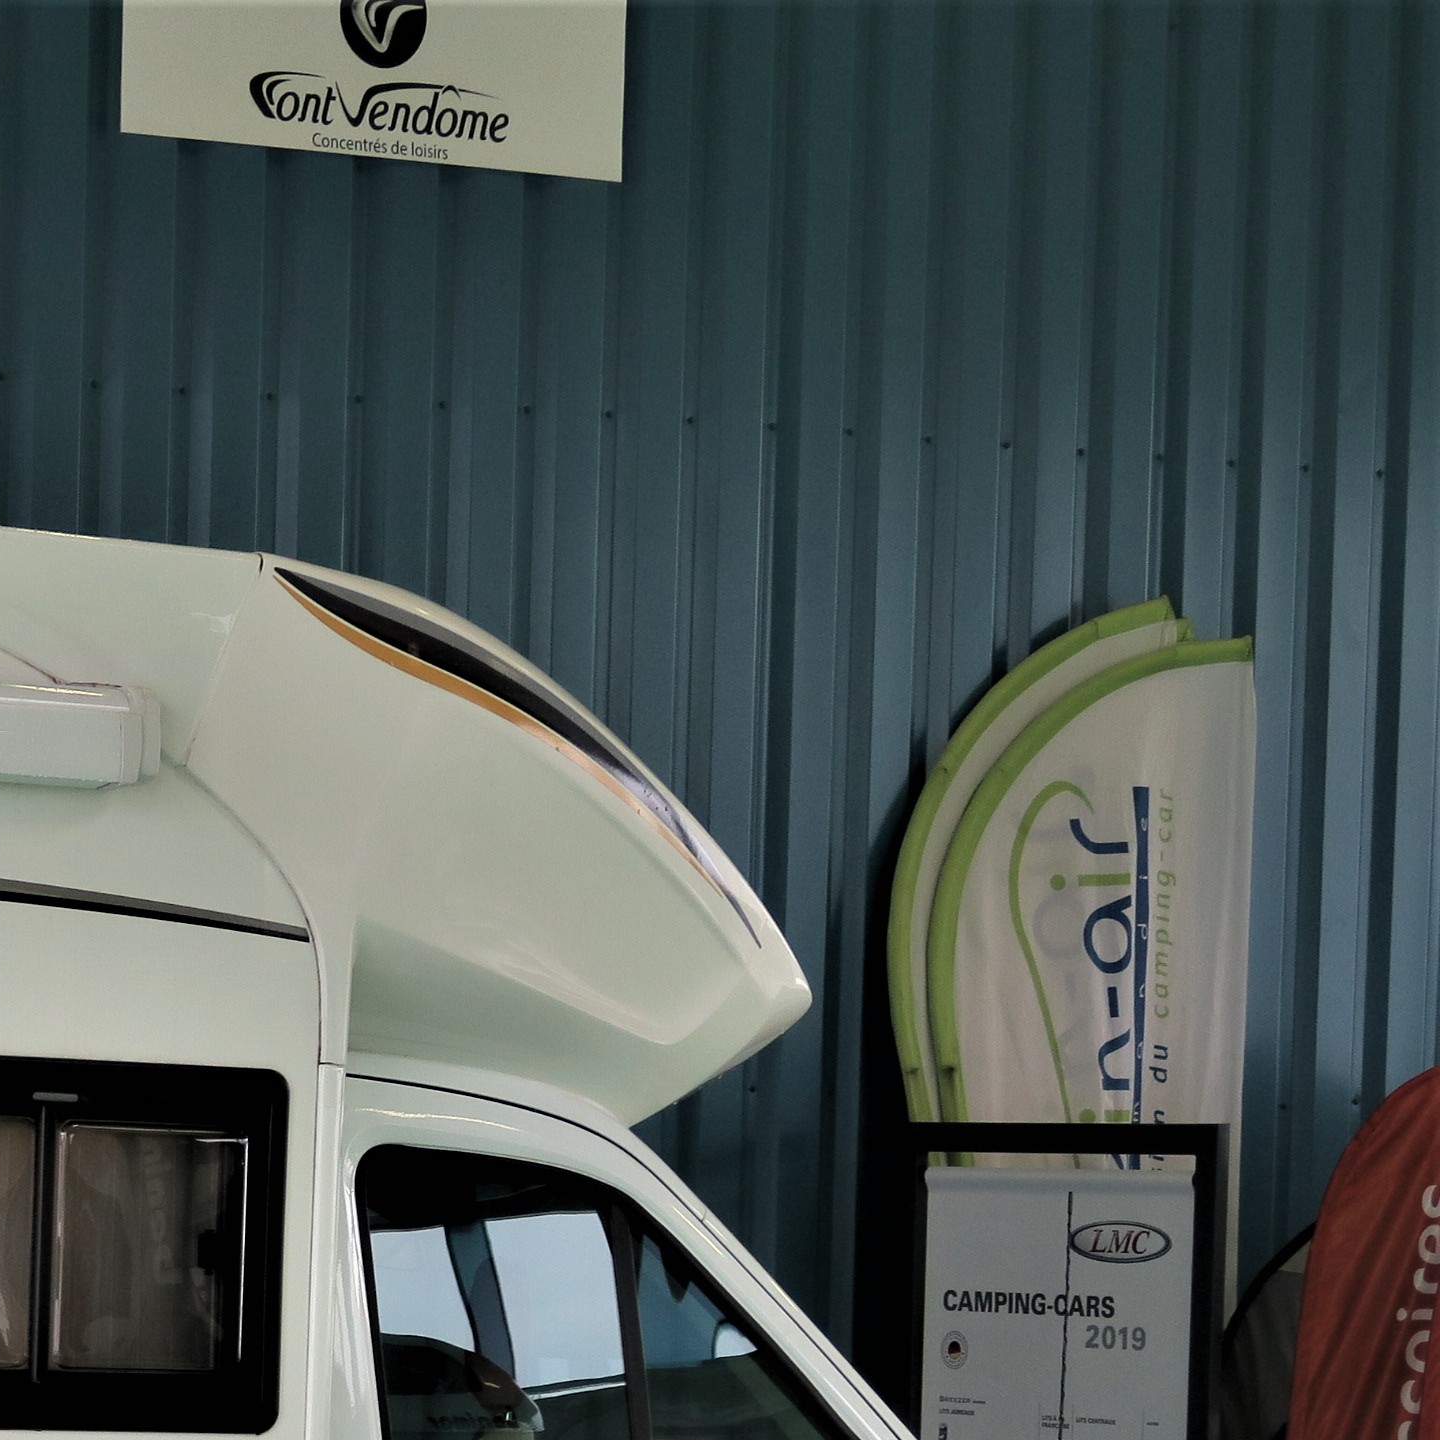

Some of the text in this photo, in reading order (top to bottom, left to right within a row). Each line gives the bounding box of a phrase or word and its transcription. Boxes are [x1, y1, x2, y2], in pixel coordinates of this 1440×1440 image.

[312, 132, 449, 160] Concentrés de loisirs
[1154, 788, 1178, 1020] camping-car
[1089, 1229, 1151, 1254] LMC
[943, 1289, 1115, 1319] CAMPING-CARS
[1085, 1324, 1146, 1351] 2019
